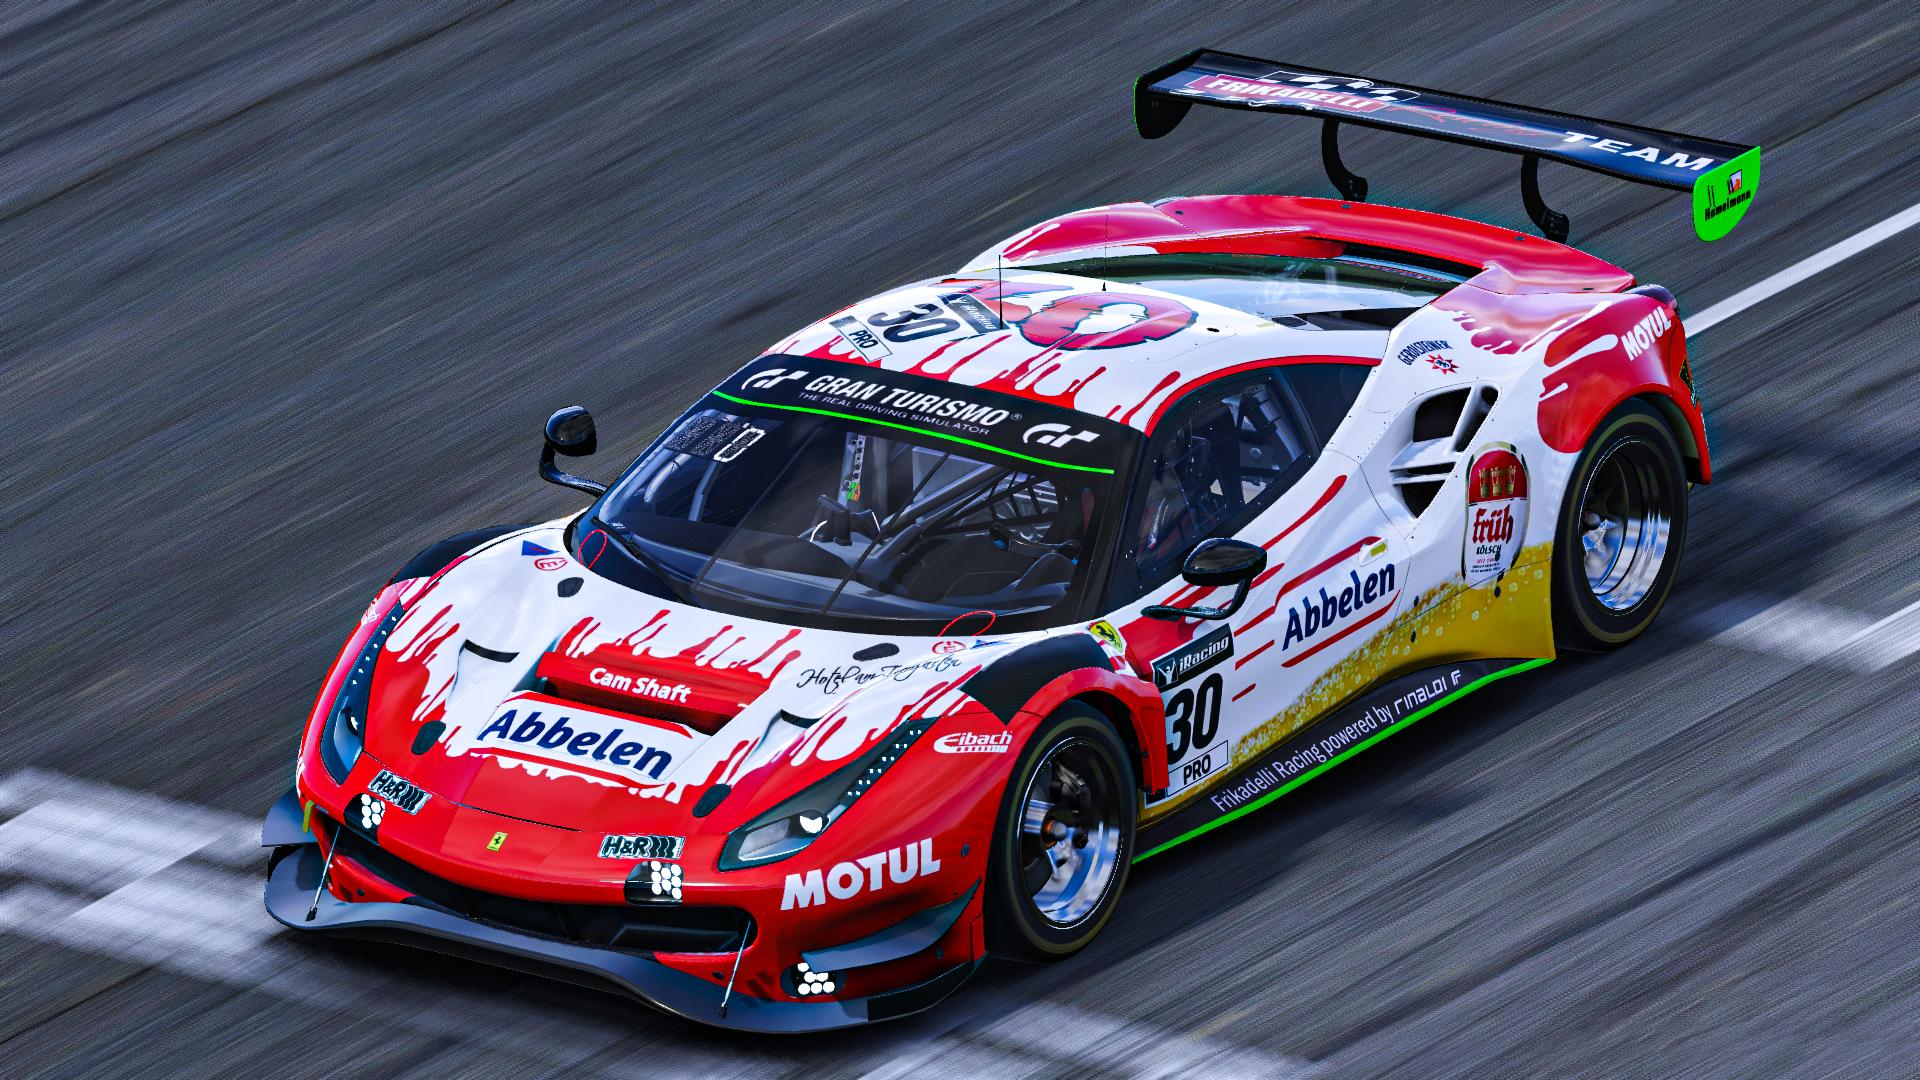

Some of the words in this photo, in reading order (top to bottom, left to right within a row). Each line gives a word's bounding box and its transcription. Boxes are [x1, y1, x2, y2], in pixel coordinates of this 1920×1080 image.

[1206, 77, 1377, 109] FRIKADELLI
[1561, 130, 1716, 171] TEAM
[849, 329, 879, 349] PRO
[867, 303, 961, 343] 30
[1620, 305, 1672, 361] MOTUL
[798, 392, 821, 402] THE
[821, 395, 852, 408] REAL
[856, 402, 909, 419] DRIVING
[910, 413, 991, 436] SIMULATOR
[804, 375, 886, 401] GRAN
[881, 387, 1012, 427] TURISMO
[1471, 504, 1514, 545] früh
[1475, 544, 1502, 555] KÖLSCH
[1281, 563, 1396, 652] Abbelen
[1179, 636, 1230, 673] iRacing
[589, 667, 631, 692] Cam
[631, 676, 692, 704] Shaft
[796, 663, 861, 695] Hotel
[1165, 673, 1224, 766] 30
[476, 708, 673, 780] Abbelen
[934, 730, 1013, 754] Eibach
[1210, 767, 1279, 812] Frikadelli
[1271, 743, 1328, 780] Racing
[1320, 710, 1378, 758] powered
[1374, 704, 1395, 724] by
[1183, 754, 1212, 786] PRO
[779, 838, 941, 911] MOTUL
